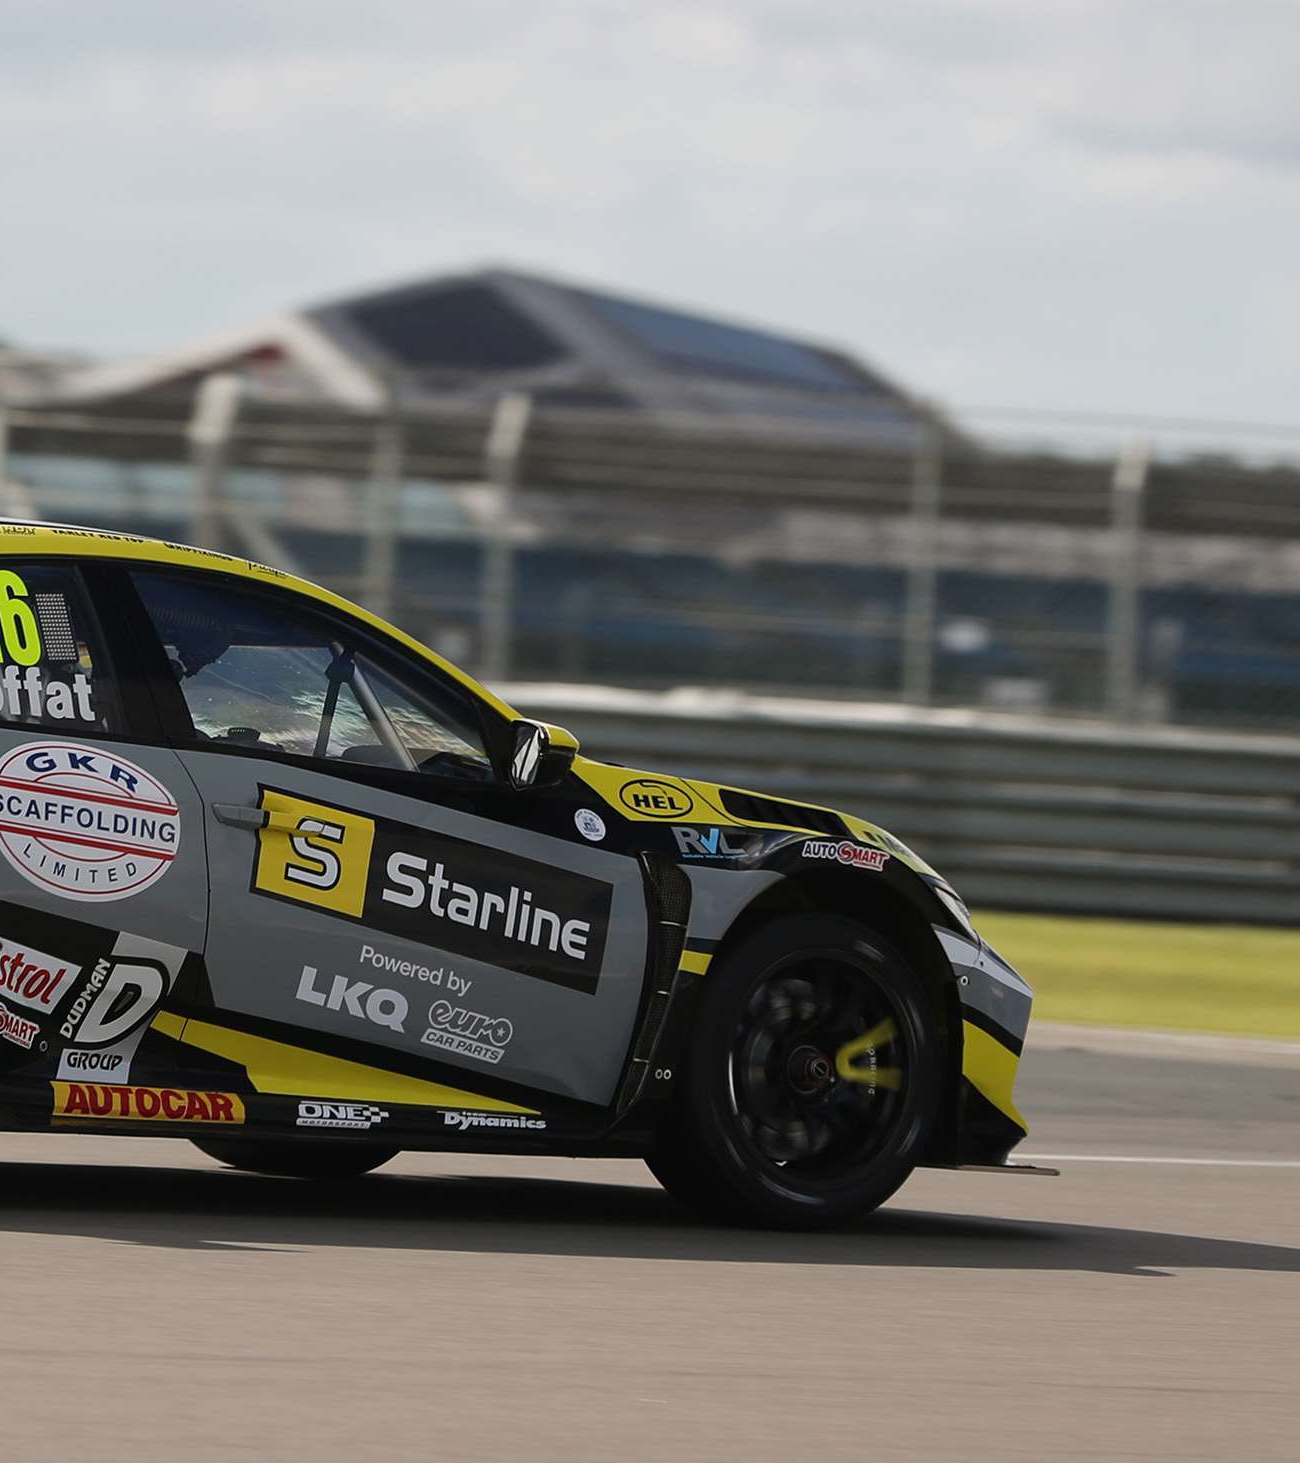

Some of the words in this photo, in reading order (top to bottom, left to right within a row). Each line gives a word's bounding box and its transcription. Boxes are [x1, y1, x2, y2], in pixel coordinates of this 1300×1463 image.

[25, 752, 139, 793] GKR
[632, 793, 684, 811] HEL
[671, 826, 747, 854] RVL
[802, 842, 889, 867] AUTOSMART
[23, 843, 138, 884] LIMITED
[382, 851, 591, 961] Starline
[360, 945, 444, 986] Powered
[447, 970, 473, 997] by
[60, 958, 112, 1039] DUDMAN
[74, 963, 164, 1044] D
[296, 965, 409, 1034] LKQ
[429, 1000, 513, 1047] euro
[66, 1051, 124, 1071] GROUP
[426, 1031, 455, 1049] CAR
[455, 1038, 501, 1061] PARTS
[63, 1084, 236, 1122] AUTOCAR
[298, 1103, 367, 1120] ONE
[444, 1112, 547, 1130] Dynamics
